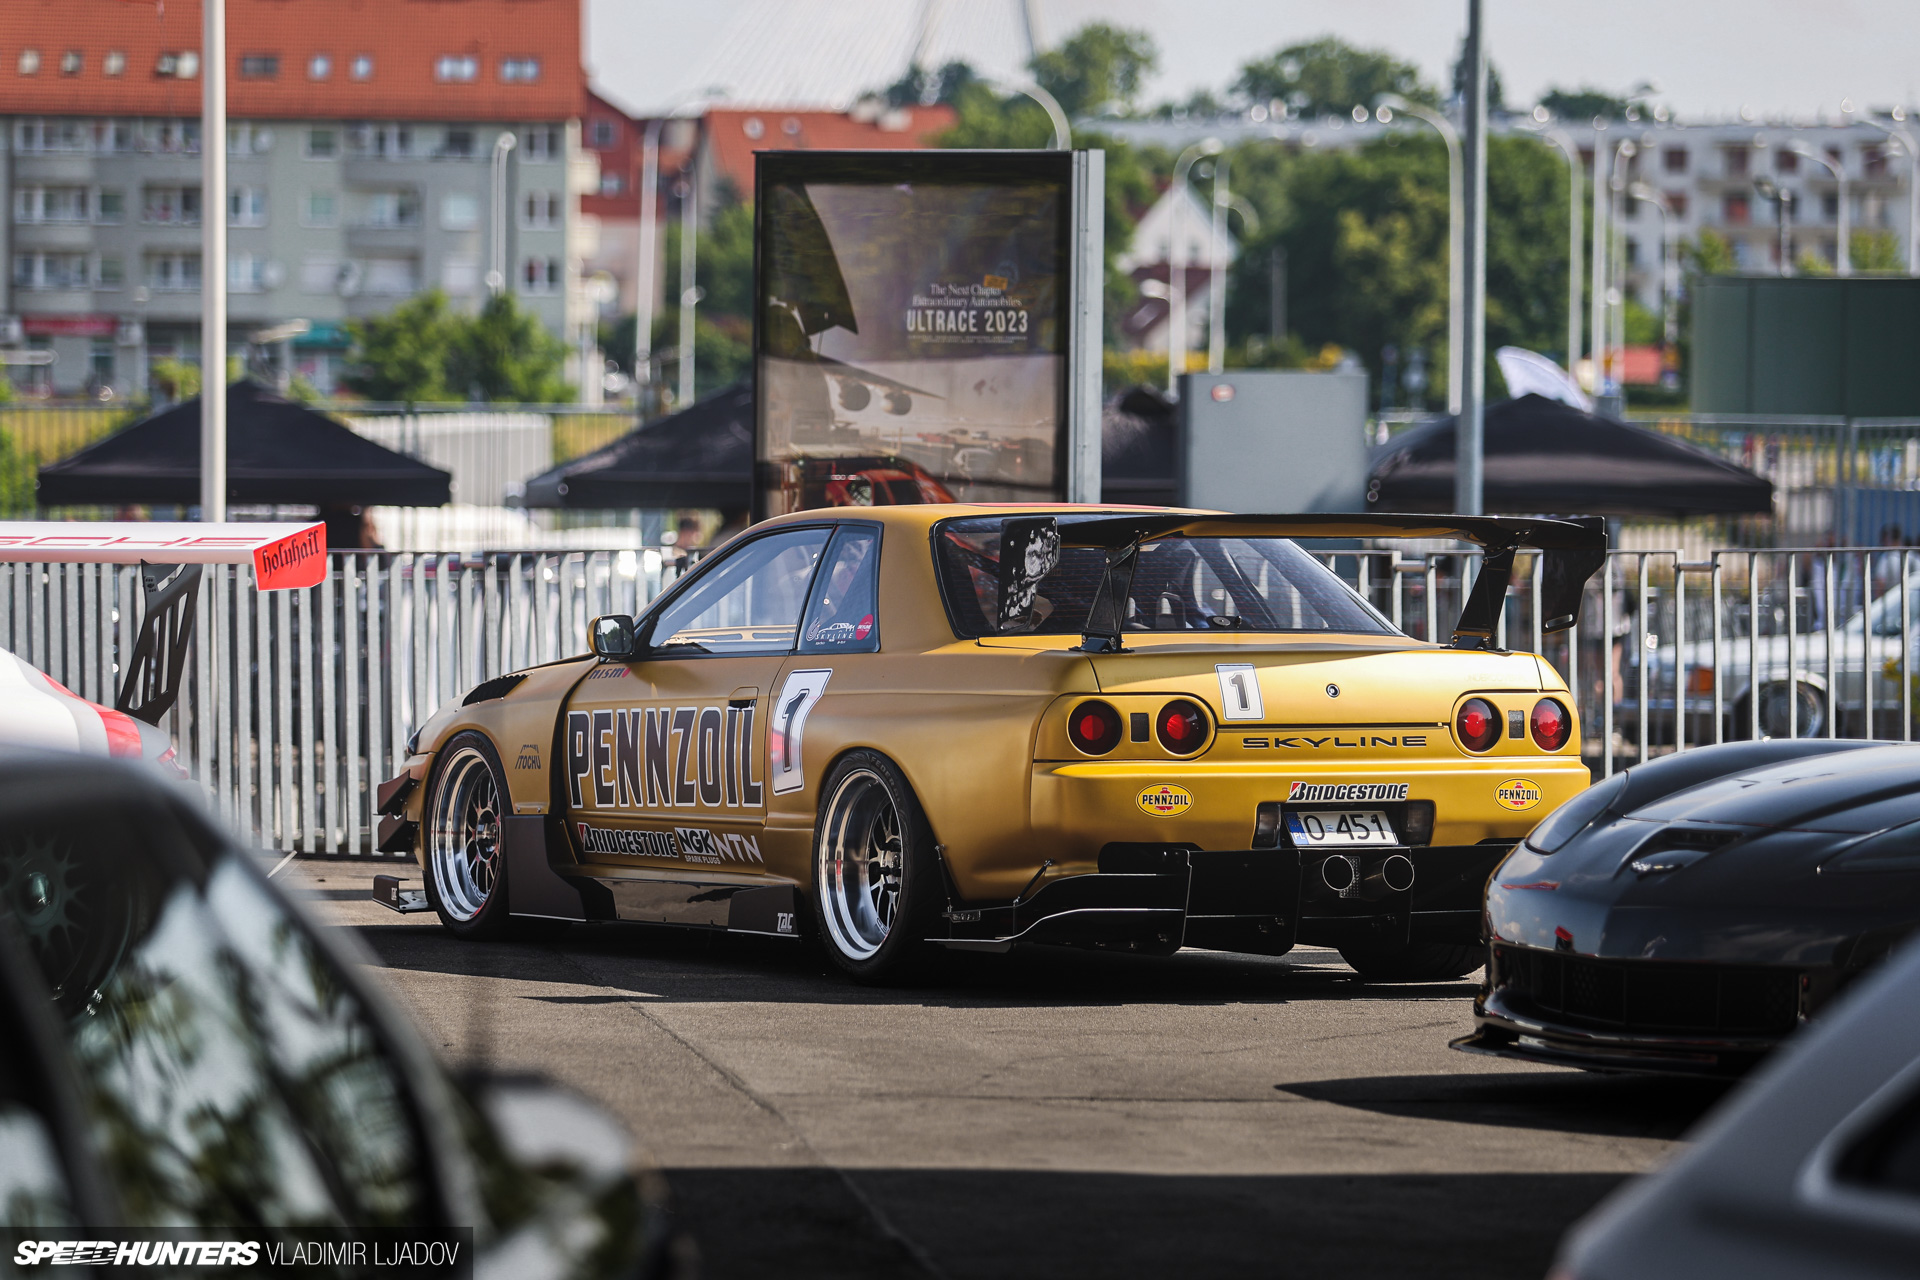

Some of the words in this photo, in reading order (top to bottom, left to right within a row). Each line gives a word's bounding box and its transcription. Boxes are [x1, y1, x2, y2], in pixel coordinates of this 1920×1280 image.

[930, 283, 946, 295] The
[948, 283, 969, 295] Next
[906, 309, 978, 332] ULTRACE
[984, 309, 1028, 333] 2023
[1229, 672, 1250, 711] 1
[782, 688, 810, 772] 1
[1242, 735, 1427, 748] SKYLINE
[514, 755, 542, 770] ITOCHU
[568, 707, 762, 808] PENNZOIL
[1142, 794, 1189, 805] PENNZOIL
[1286, 781, 1409, 802] BRIDGESTONE
[1499, 789, 1539, 800] PENNZOIL
[1294, 832, 1306, 840] PL
[1336, 814, 1386, 840] 451
[577, 822, 679, 857] BRIDGESTONE
[676, 829, 717, 855] NGK
[712, 833, 764, 863] NTN
[684, 854, 703, 863] SPARK
[703, 856, 721, 865] PLUGS
